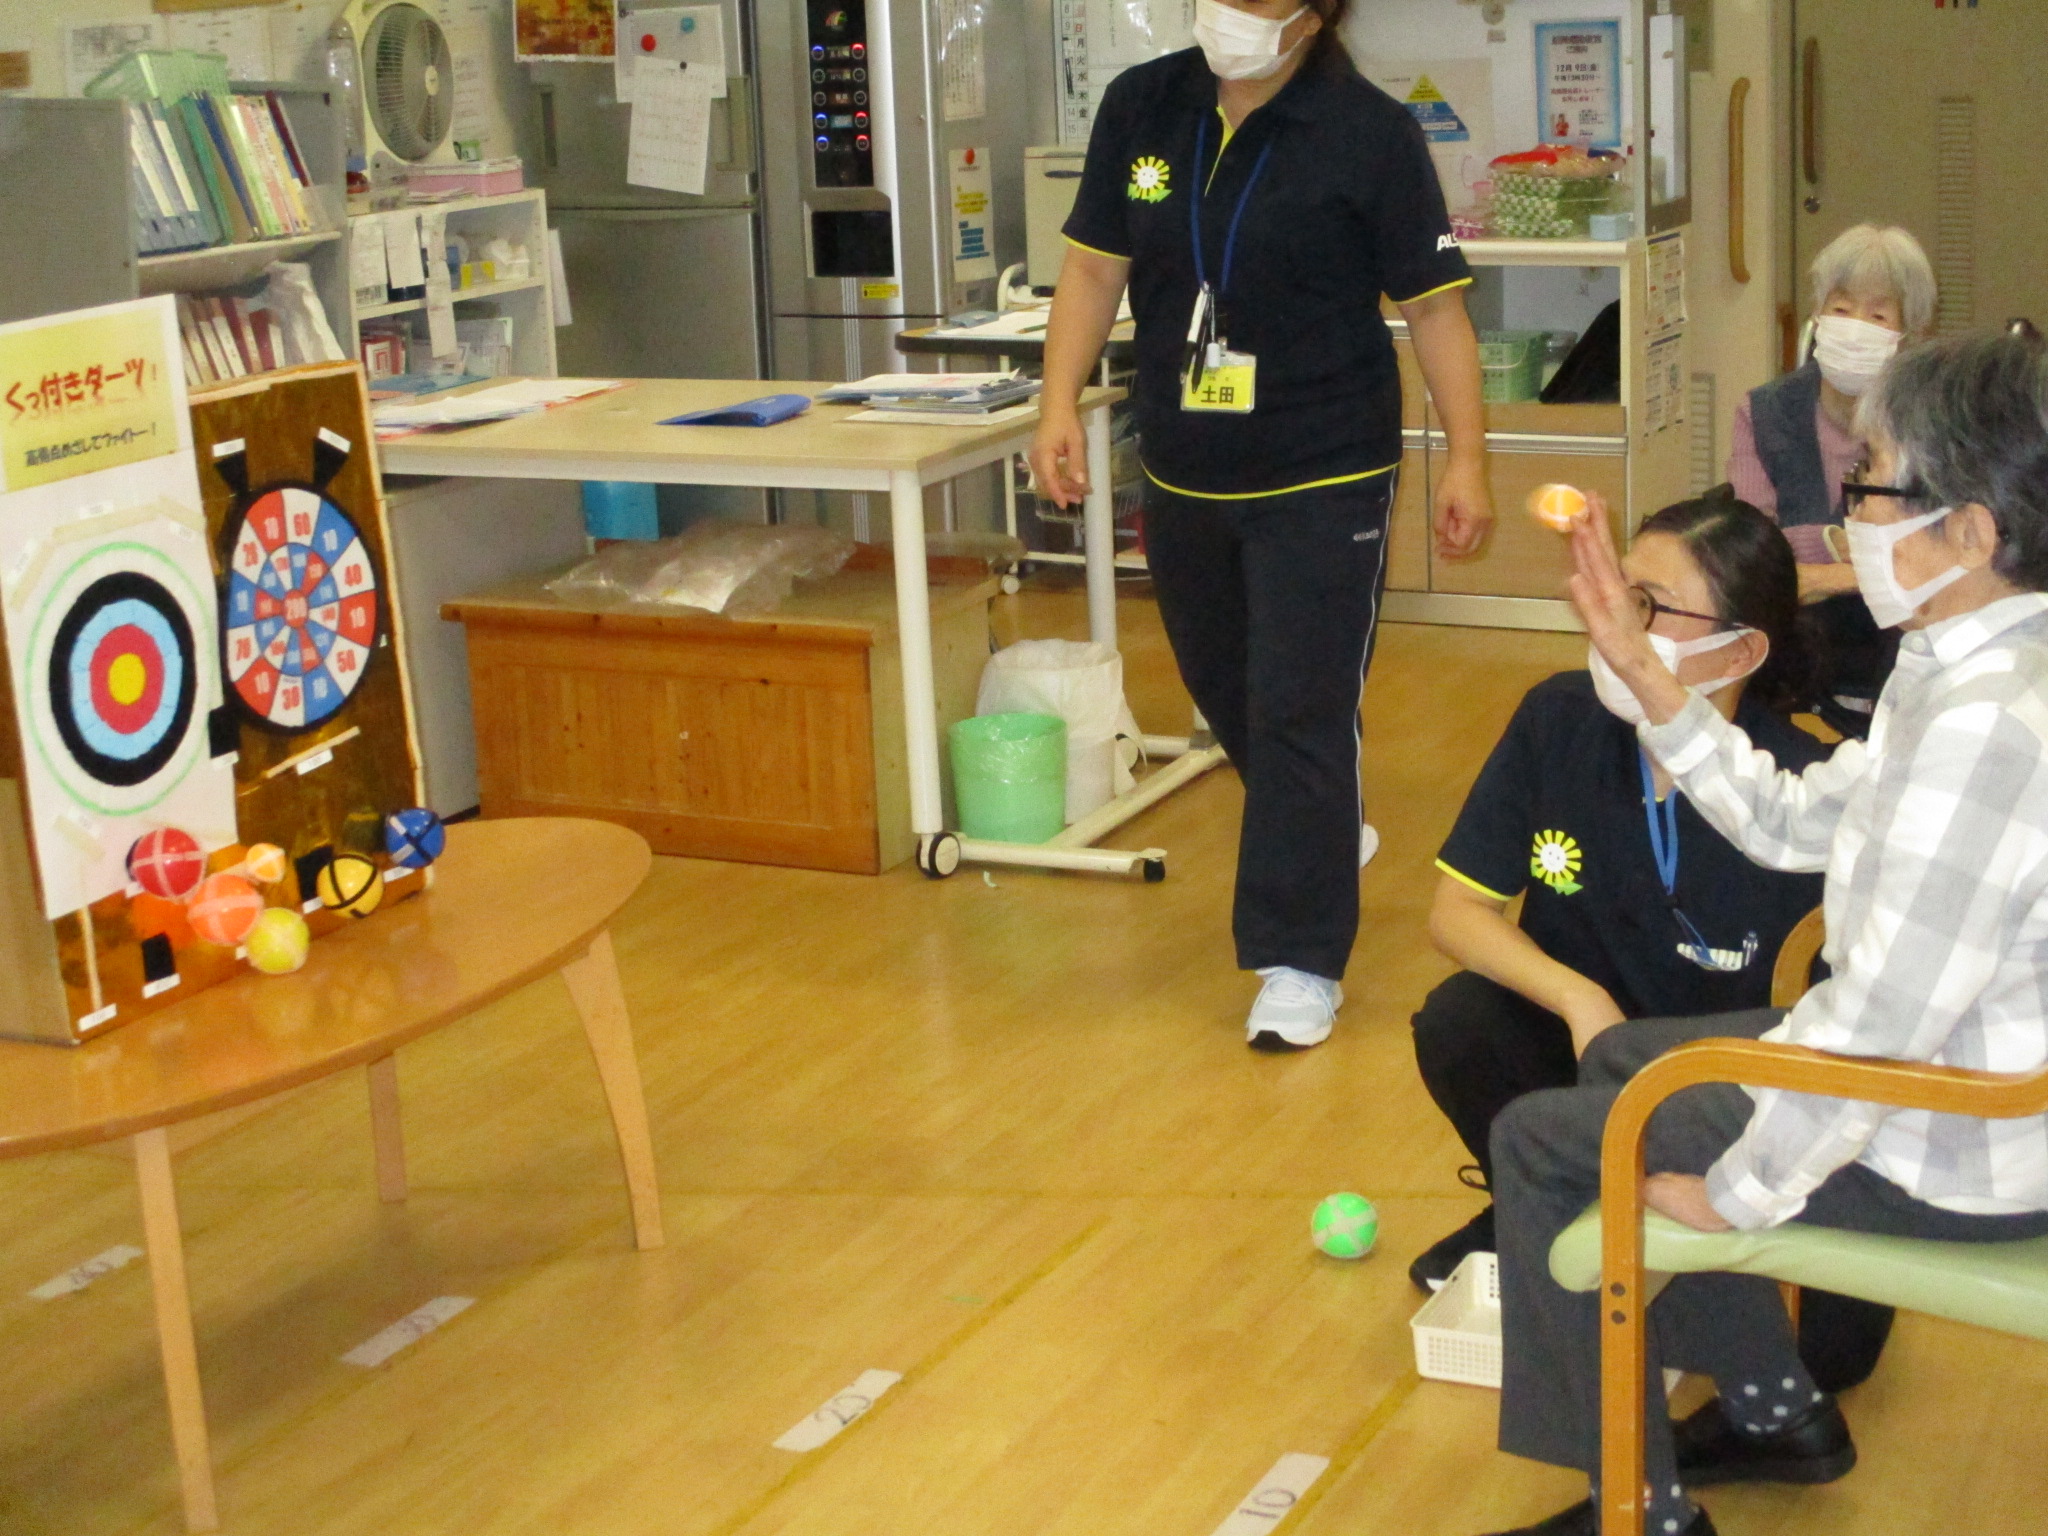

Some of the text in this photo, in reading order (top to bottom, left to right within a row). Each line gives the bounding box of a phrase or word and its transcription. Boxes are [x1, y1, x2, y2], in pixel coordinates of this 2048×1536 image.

[1200, 385, 1234, 404] 土田
[264, 517, 280, 540] 10
[293, 512, 311, 537] 60
[323, 529, 338, 551] 10
[344, 563, 362, 586] 40
[349, 606, 366, 628] 10
[236, 637, 251, 661] 70
[336, 649, 356, 673] 50
[254, 671, 270, 694] 10
[312, 677, 328, 700] 10
[282, 686, 300, 710] 30
[814, 1394, 872, 1426] 20
[1239, 1487, 1297, 1520] 10
